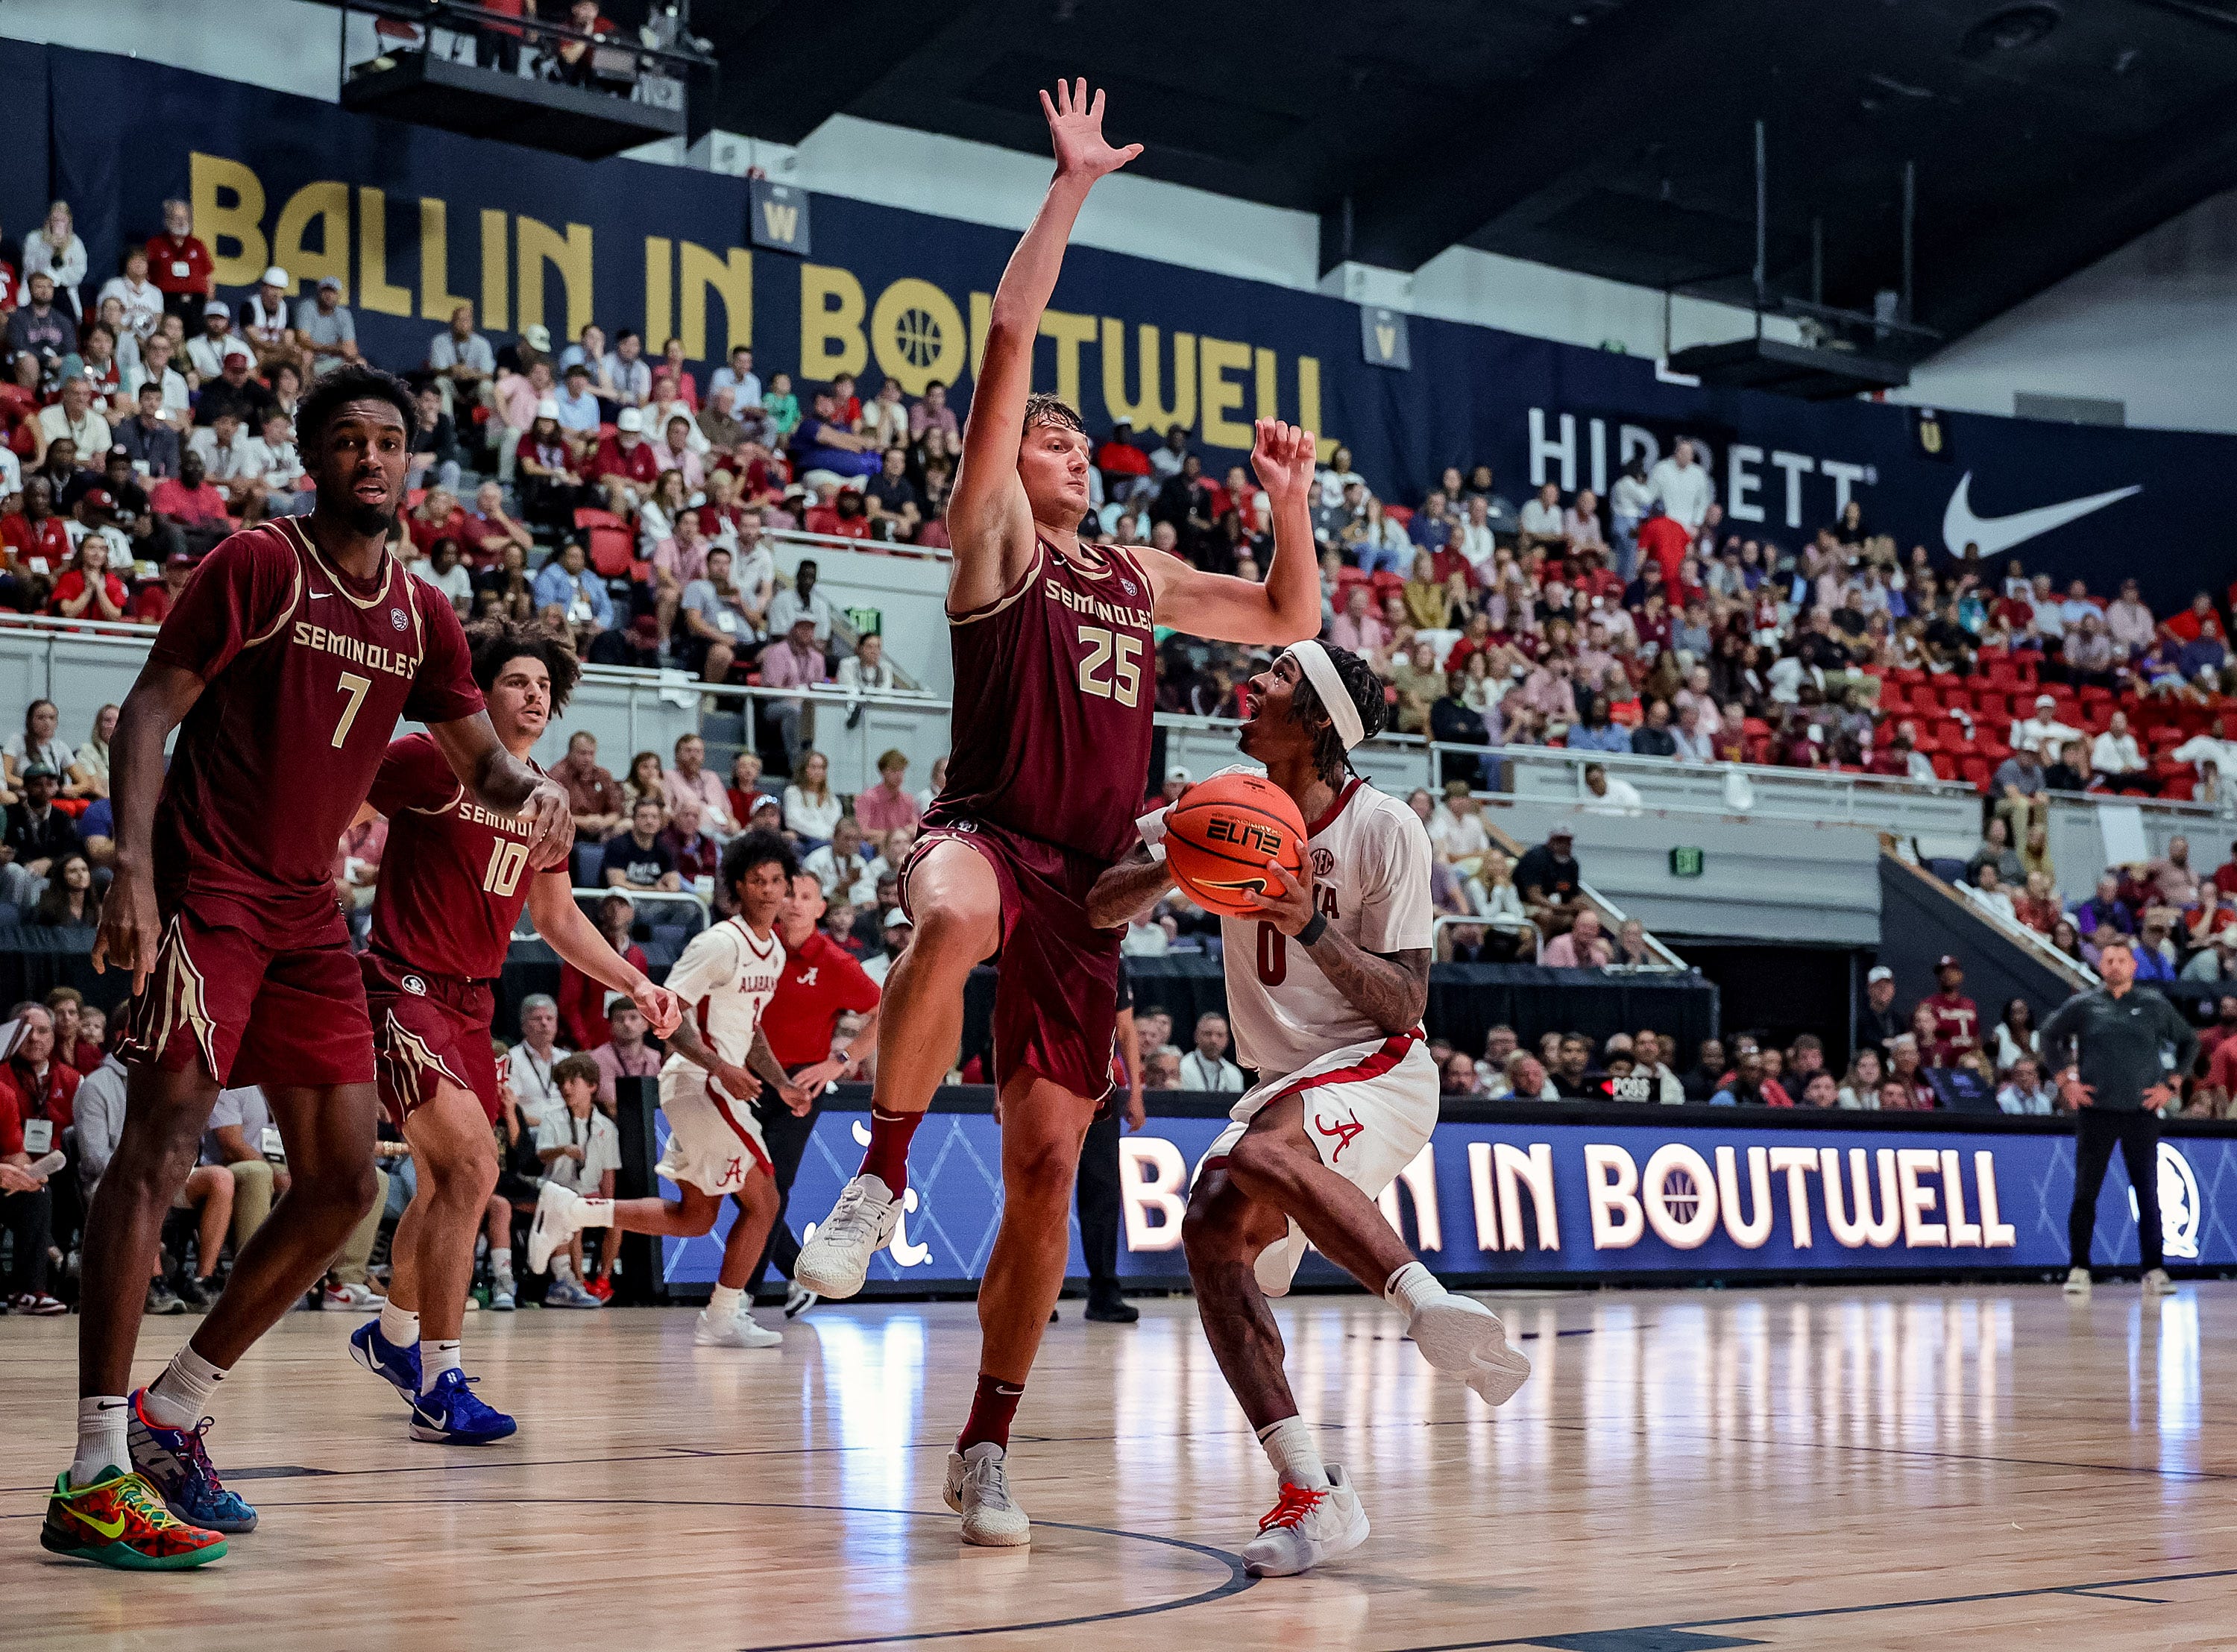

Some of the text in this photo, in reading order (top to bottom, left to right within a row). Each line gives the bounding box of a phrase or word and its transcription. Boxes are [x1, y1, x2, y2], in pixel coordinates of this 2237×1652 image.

[762, 201, 799, 243] W
[189, 151, 593, 342] BALLIN
[645, 235, 753, 362] IN
[293, 621, 418, 680] SEMINOLES
[1078, 625, 1143, 707] 25
[331, 671, 372, 748] 7
[458, 802, 534, 837] SEMINO
[1206, 817, 1283, 858] ELITE
[1211, 812, 1284, 836] CHAMPIONIP
[483, 836, 530, 897] 10
[1256, 919, 1287, 986] 0
[738, 975, 777, 993] ALABA
[1315, 1108, 1365, 1163] A
[1467, 1142, 1560, 1252] IN
[1584, 1143, 2016, 1250] BOUTWELL
